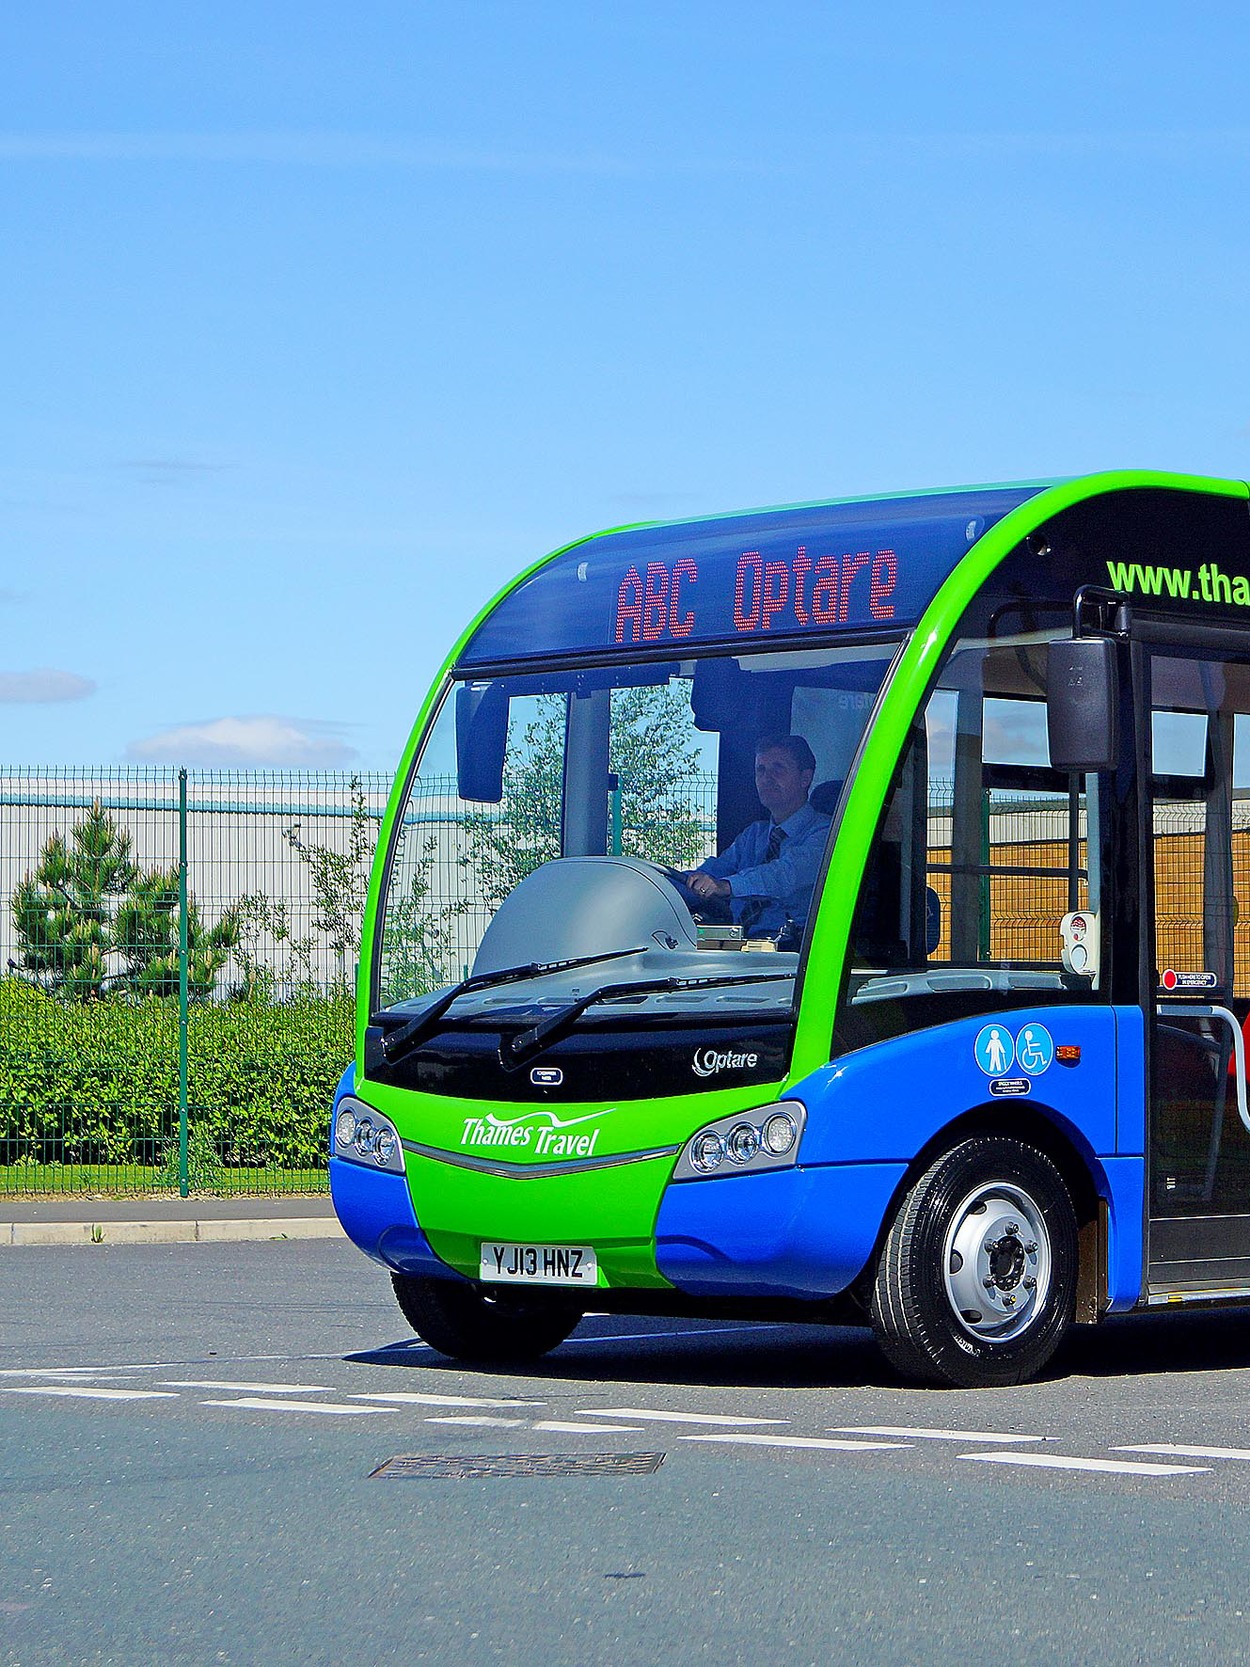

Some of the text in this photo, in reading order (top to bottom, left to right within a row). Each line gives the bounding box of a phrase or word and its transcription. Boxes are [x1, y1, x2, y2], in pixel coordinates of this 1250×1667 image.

[615, 546, 898, 642] ABC Optare
[703, 1050, 758, 1073] Optare
[461, 1118, 600, 1156] Thames Travel
[493, 1246, 583, 1278] YJ13 HNZ
